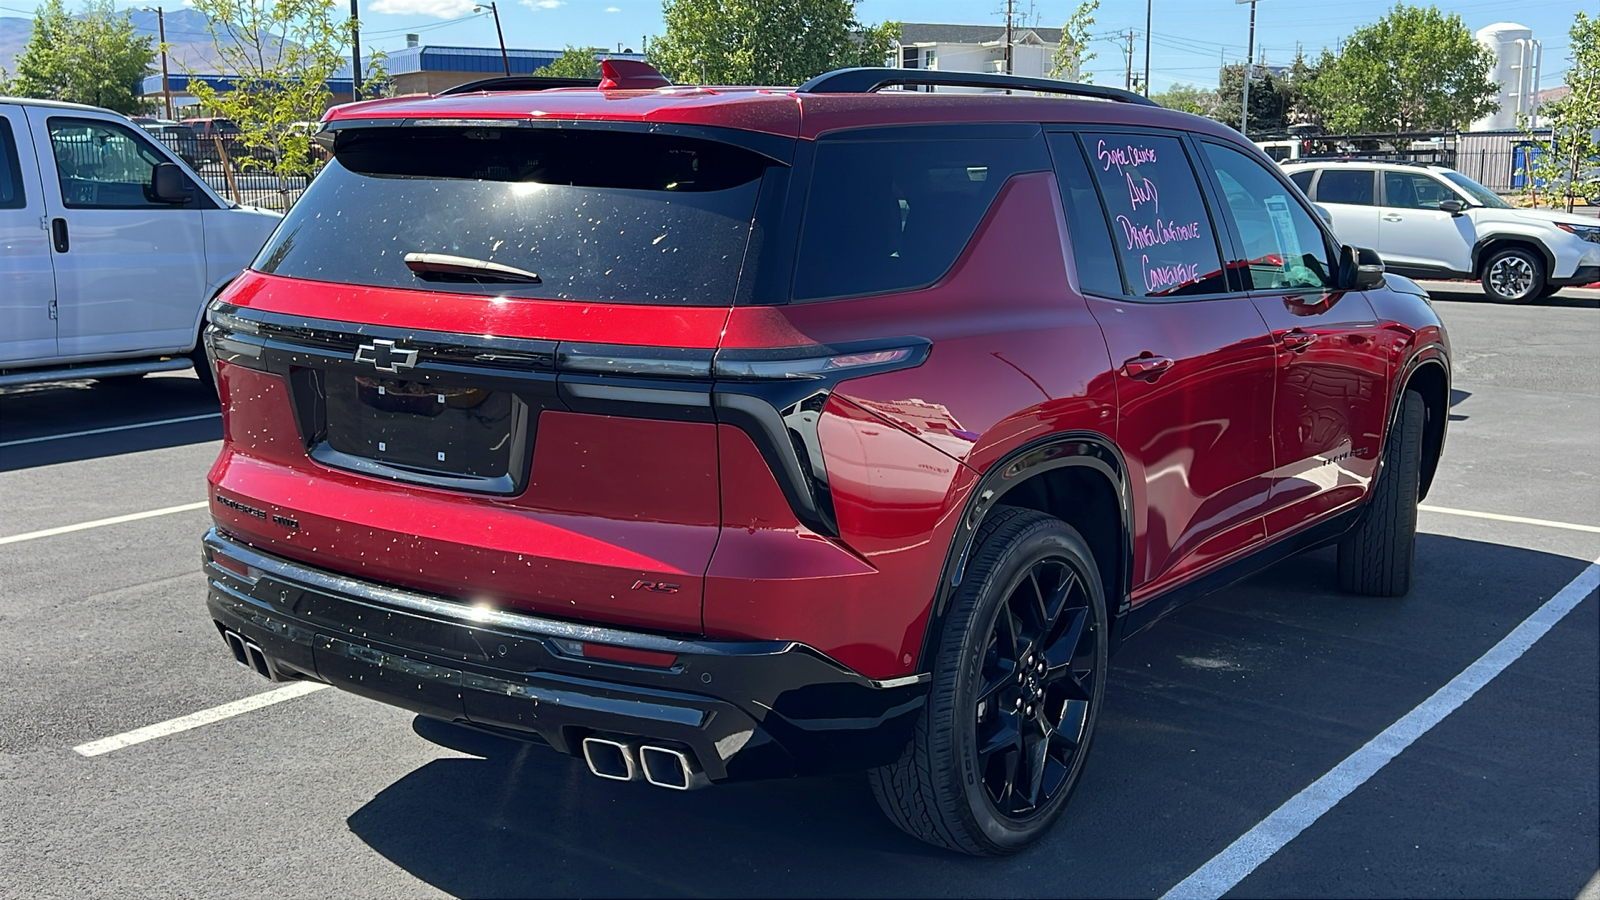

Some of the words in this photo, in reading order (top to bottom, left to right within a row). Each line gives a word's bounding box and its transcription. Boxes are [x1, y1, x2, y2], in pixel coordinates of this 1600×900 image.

[1125, 172, 1158, 214] AWD
[215, 494, 268, 519] TRAVERSE
[272, 514, 299, 528] AWD
[631, 580, 680, 594] RS
